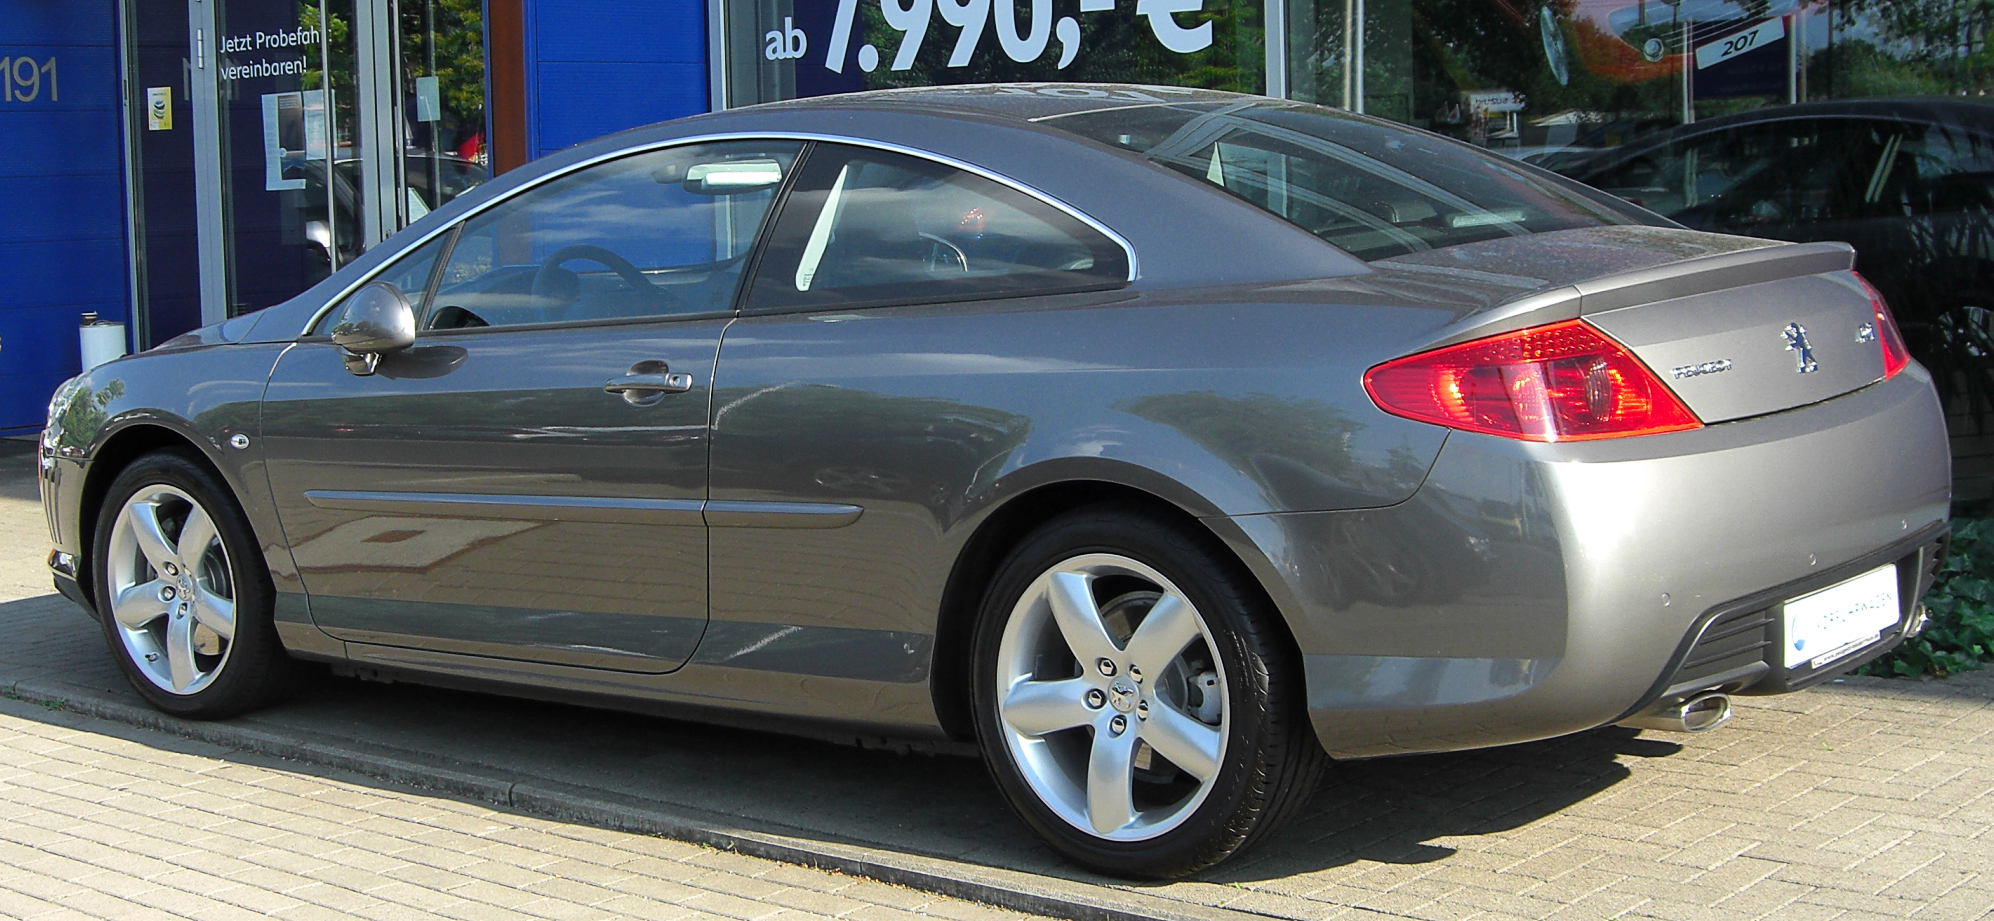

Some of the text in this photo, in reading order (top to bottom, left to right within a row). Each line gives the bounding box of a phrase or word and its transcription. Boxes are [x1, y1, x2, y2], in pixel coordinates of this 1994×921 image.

[220, 25, 332, 53] Jetzt Probefah
[765, 17, 807, 60] ab
[1720, 29, 1759, 57] 207
[0, 56, 58, 102] 191
[220, 55, 306, 80] vereinbaren!
